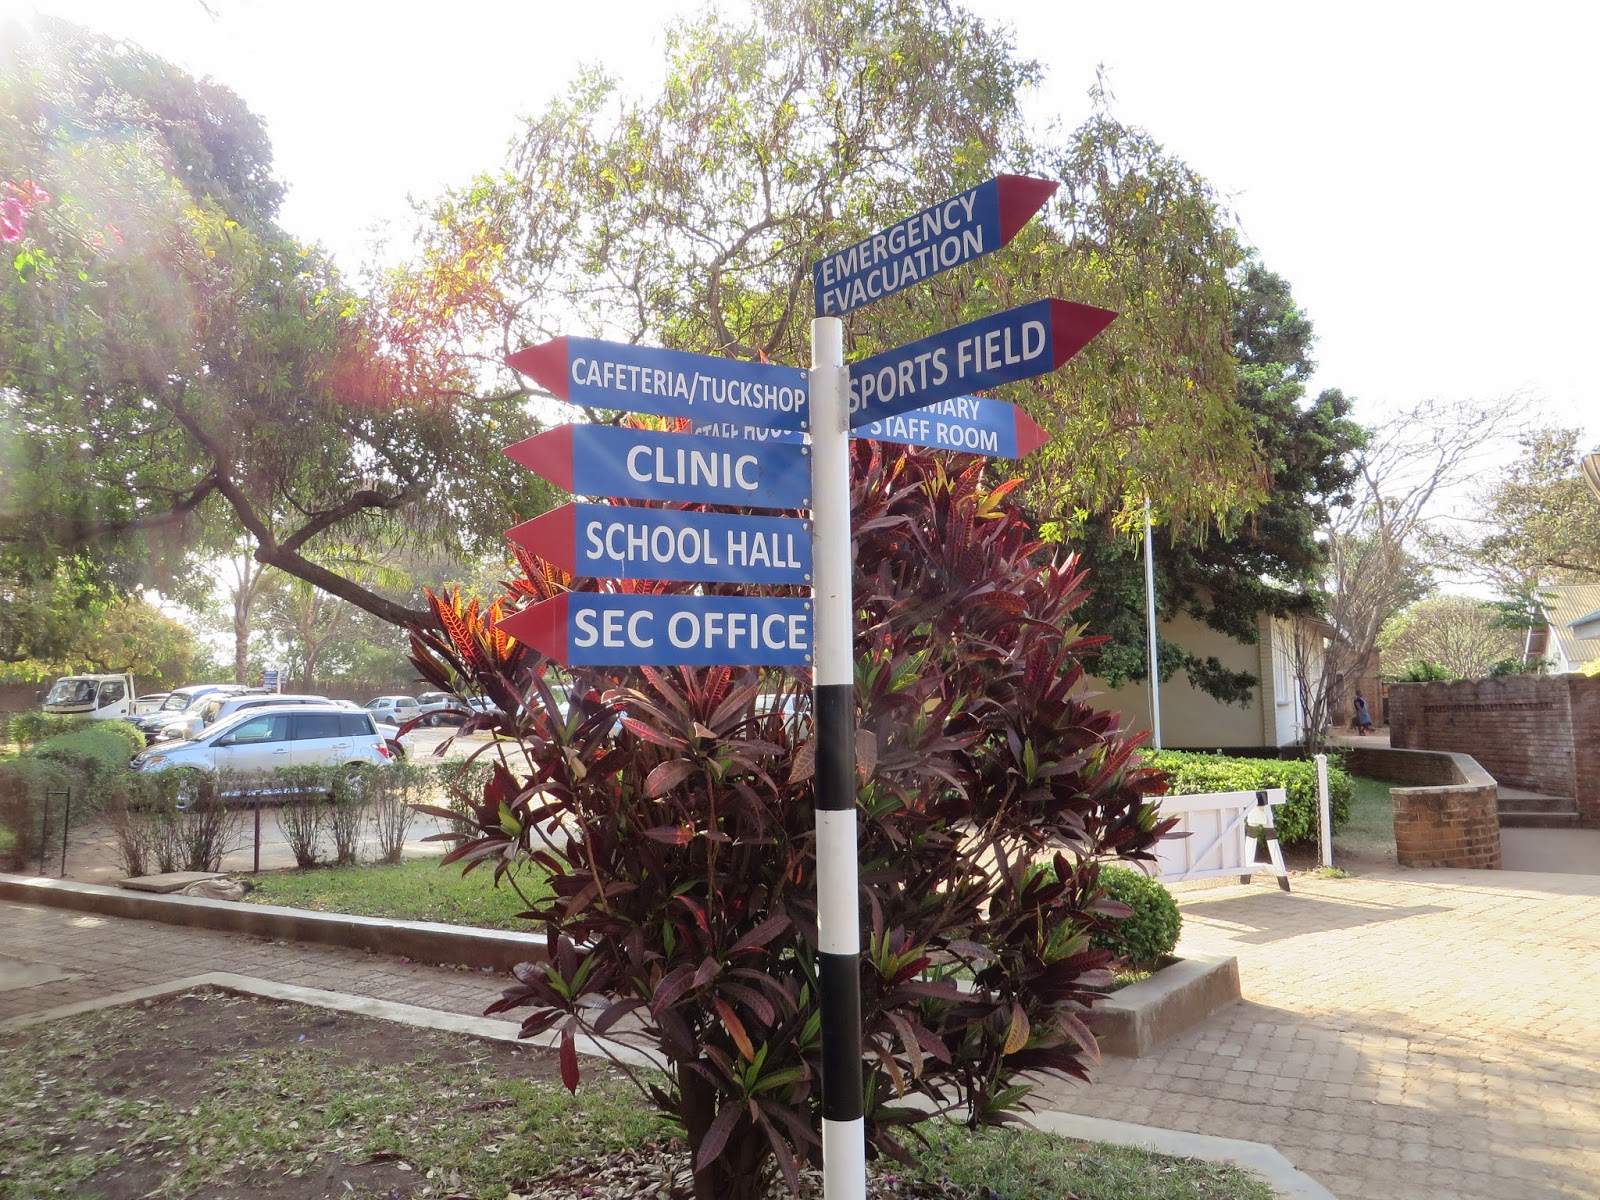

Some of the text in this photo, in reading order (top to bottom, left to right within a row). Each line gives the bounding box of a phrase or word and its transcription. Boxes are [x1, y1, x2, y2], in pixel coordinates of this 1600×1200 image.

[822, 190, 977, 287] EMERGENCY
[823, 225, 983, 316] EVACUATION
[571, 357, 806, 413] CAFETERIA/TUCKSHOP
[849, 320, 1046, 414] SPORTS FIELD
[870, 416, 998, 452] STAFF ROOM
[626, 445, 759, 490] CLINIC
[586, 521, 801, 568] SCHOOL HALL
[574, 608, 808, 650] SEC OFFICE
